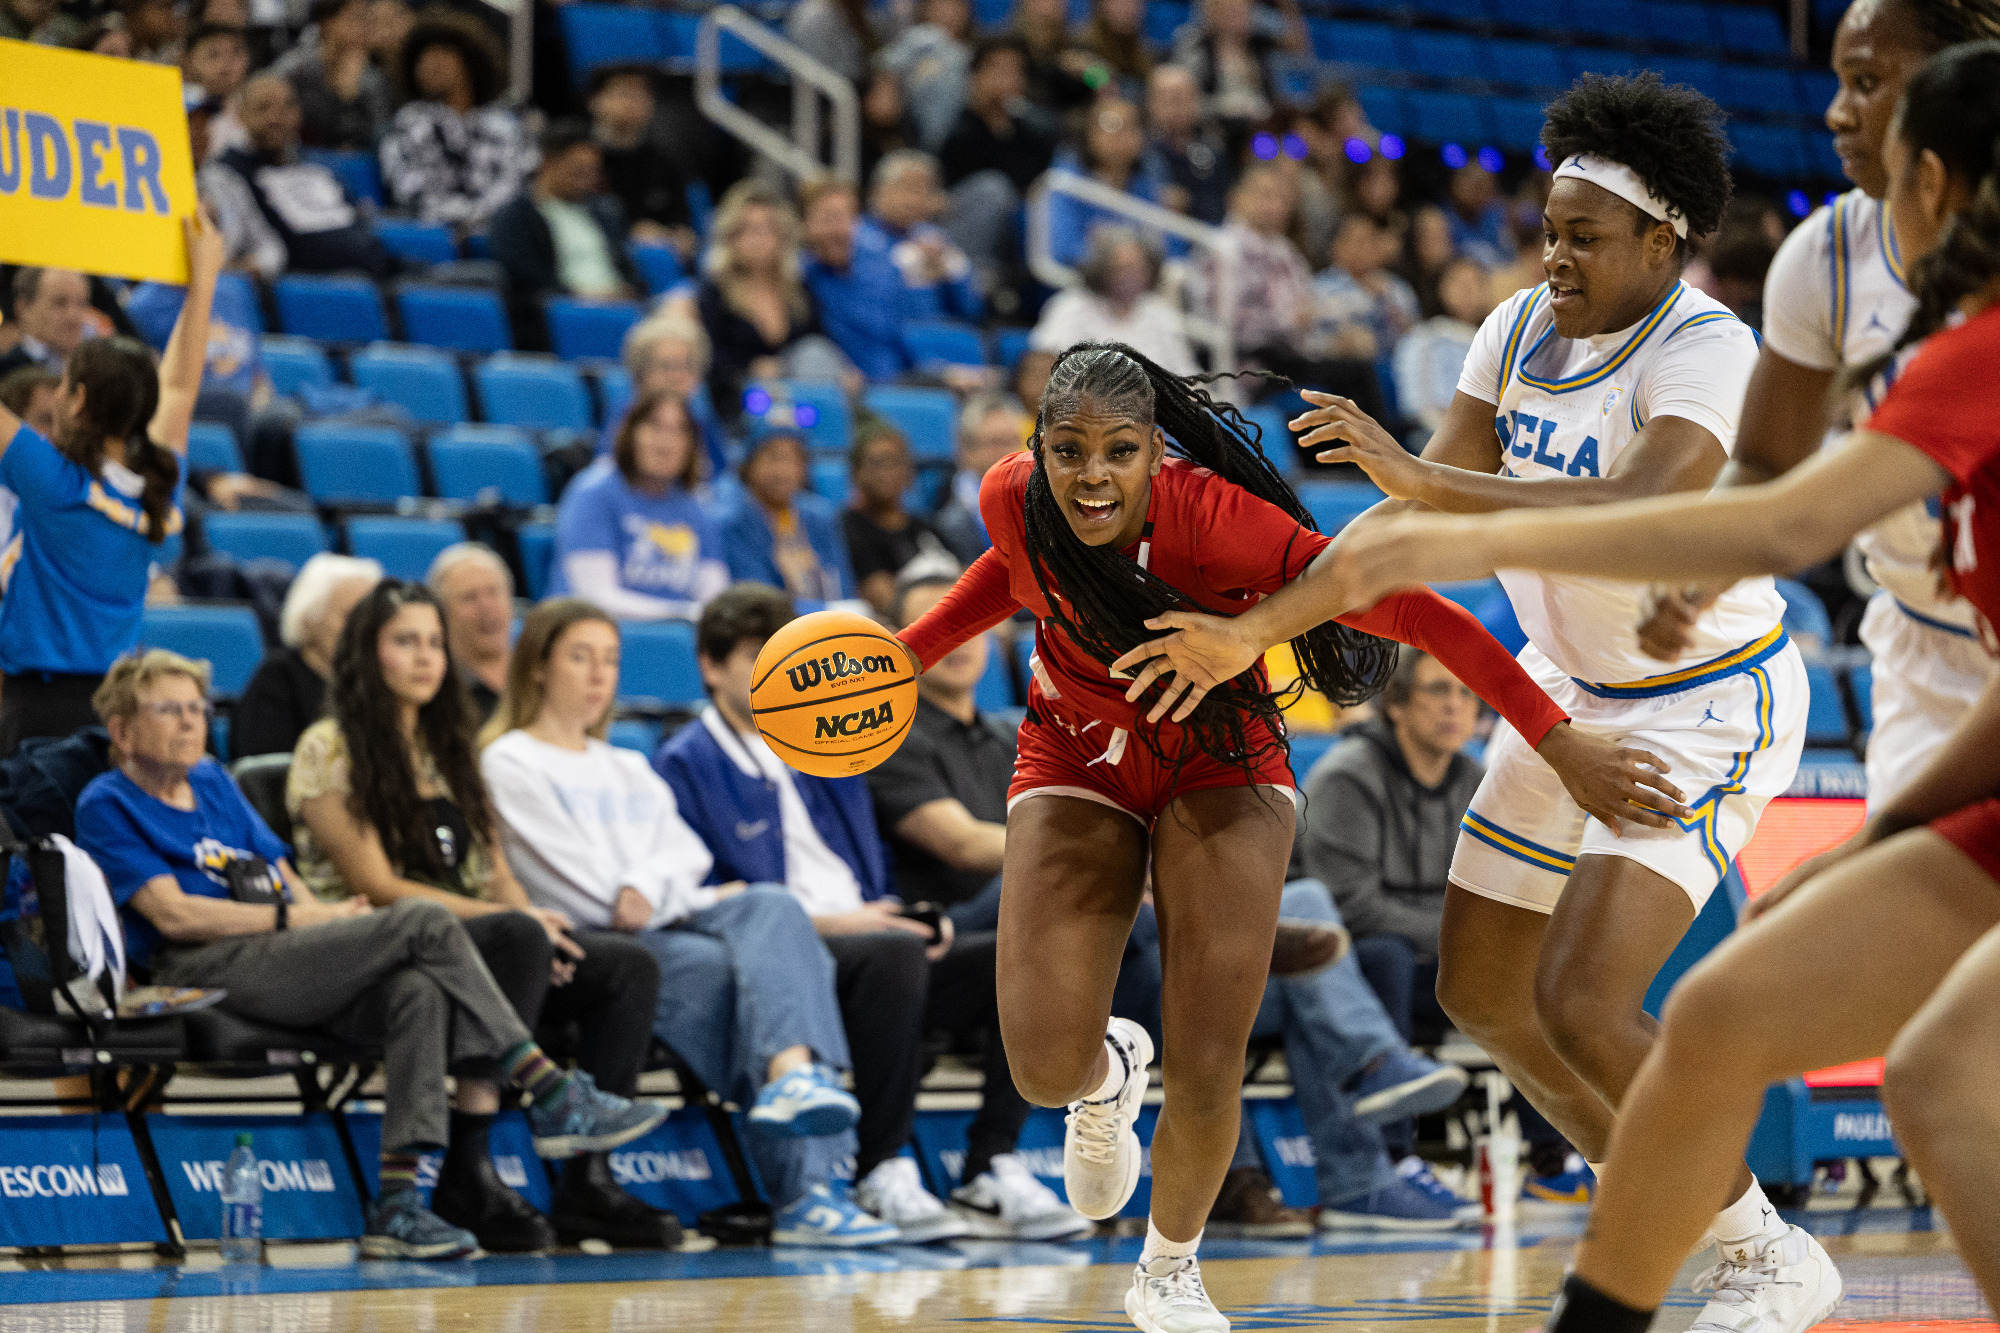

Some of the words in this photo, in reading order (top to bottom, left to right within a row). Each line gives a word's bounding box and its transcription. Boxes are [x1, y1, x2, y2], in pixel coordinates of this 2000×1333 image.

[786, 651, 896, 691] Wilson
[830, 681, 848, 689] EVO
[850, 676, 865, 684] NXT
[815, 700, 893, 738] NCAA
[0, 1164, 99, 1198] ESCOM
[607, 1151, 682, 1185] SCOM
